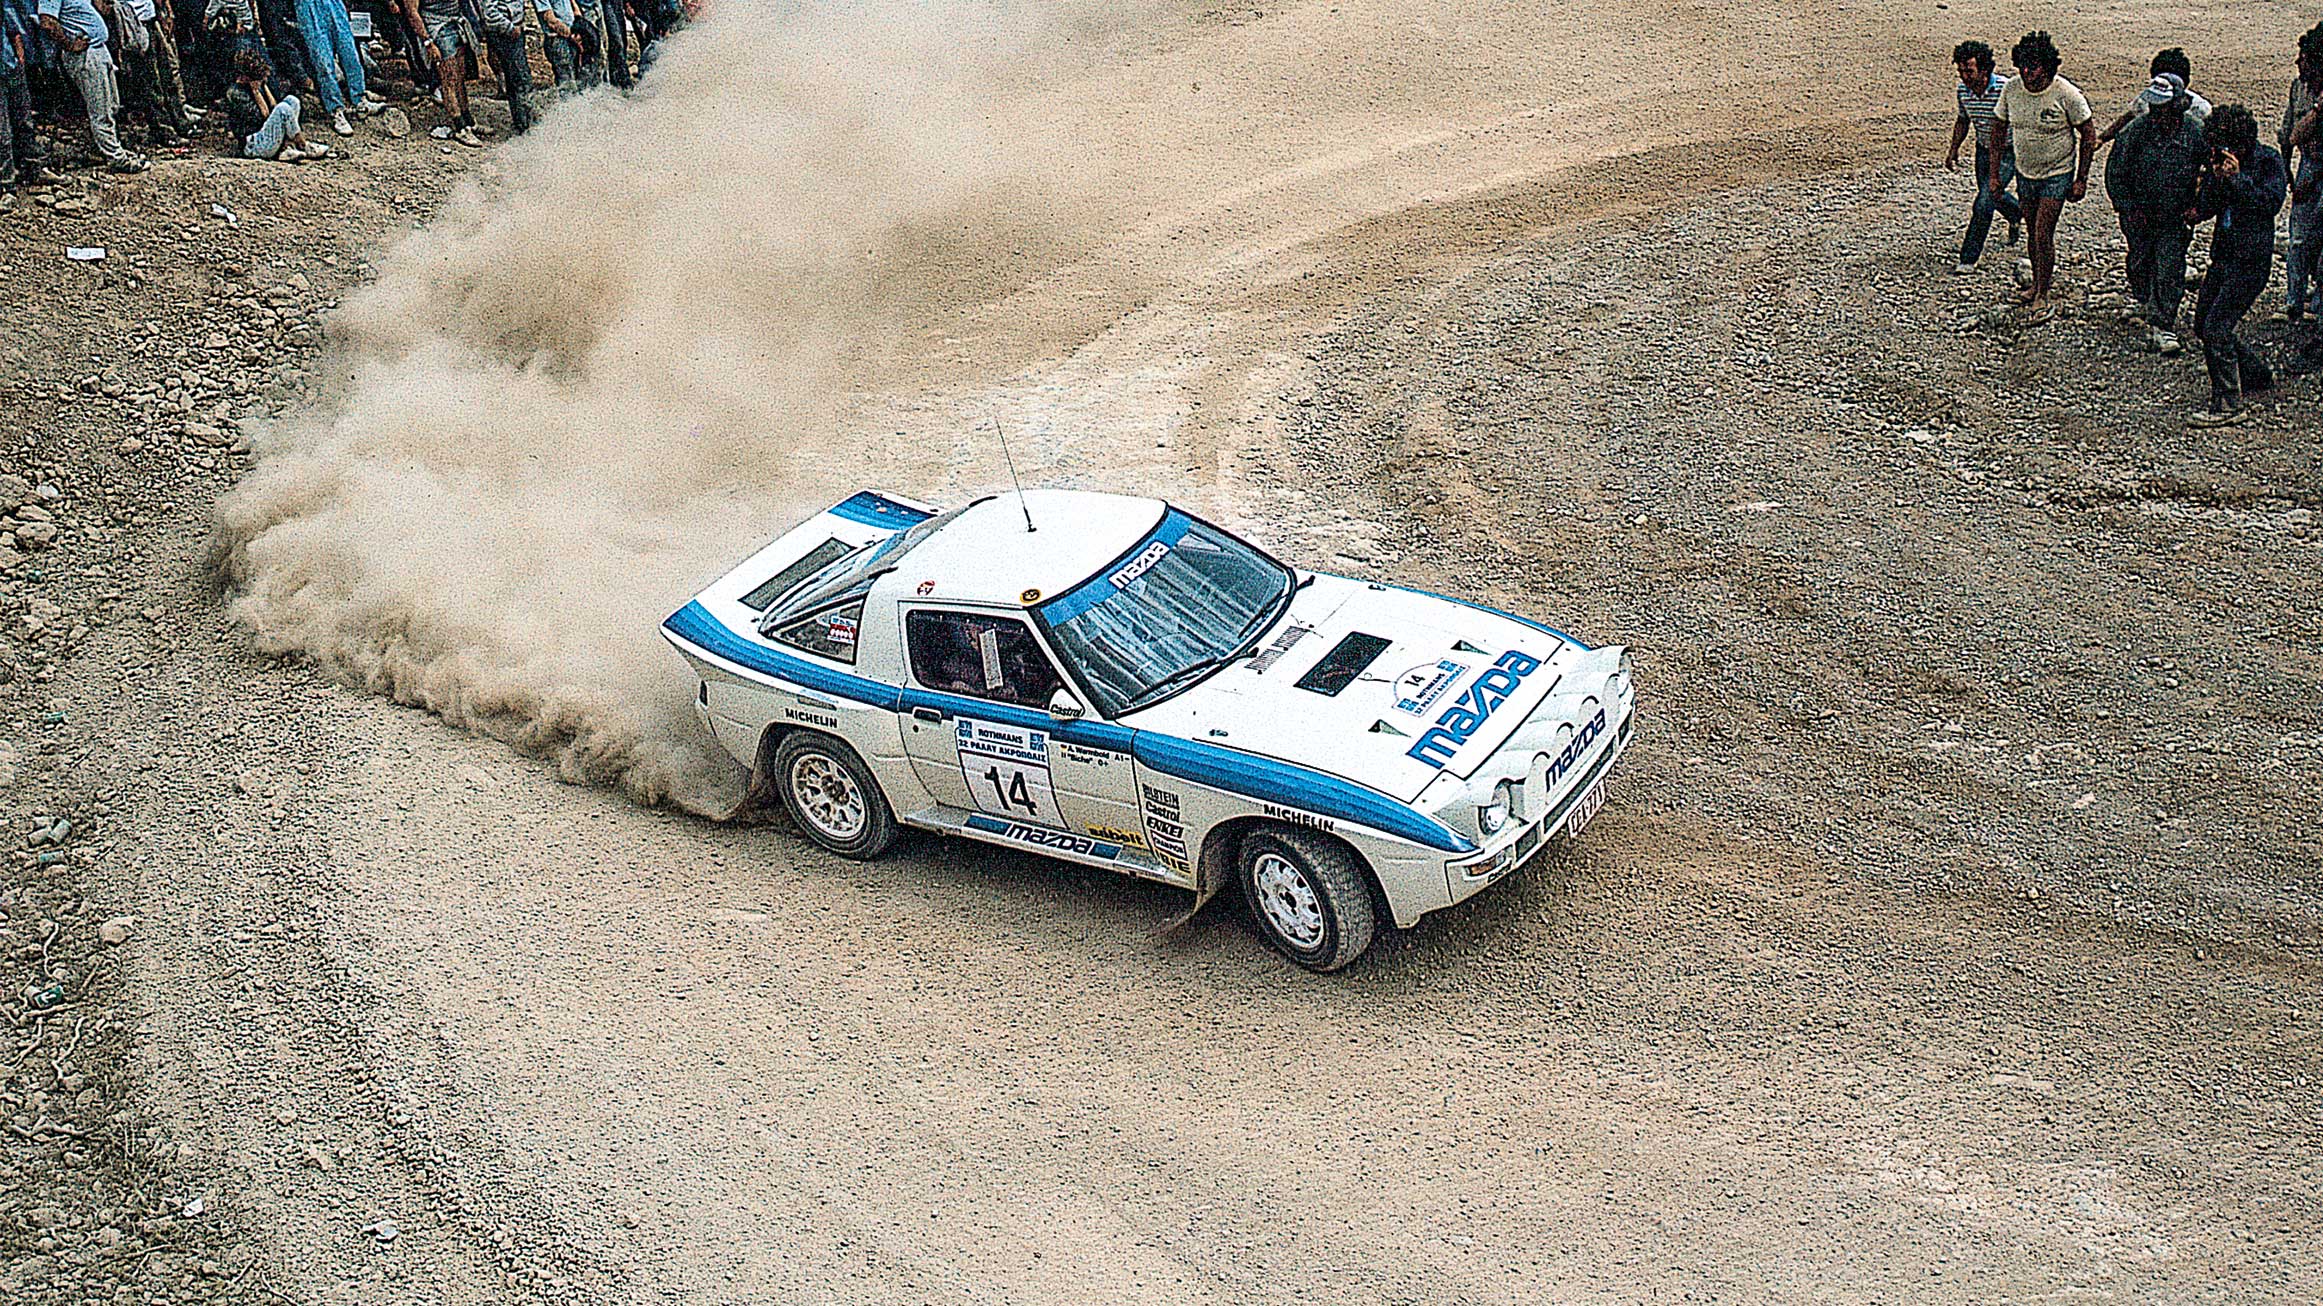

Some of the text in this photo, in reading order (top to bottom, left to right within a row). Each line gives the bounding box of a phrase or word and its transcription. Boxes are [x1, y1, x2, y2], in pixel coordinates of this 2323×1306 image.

[1404, 675, 1426, 687] 14
[785, 708, 838, 728] MICHELIN
[978, 729, 1024, 744] ROTHMANS
[984, 766, 1038, 817] 14
[1146, 801, 1180, 823] Castrol
[1263, 804, 1335, 832] MICHELIN
